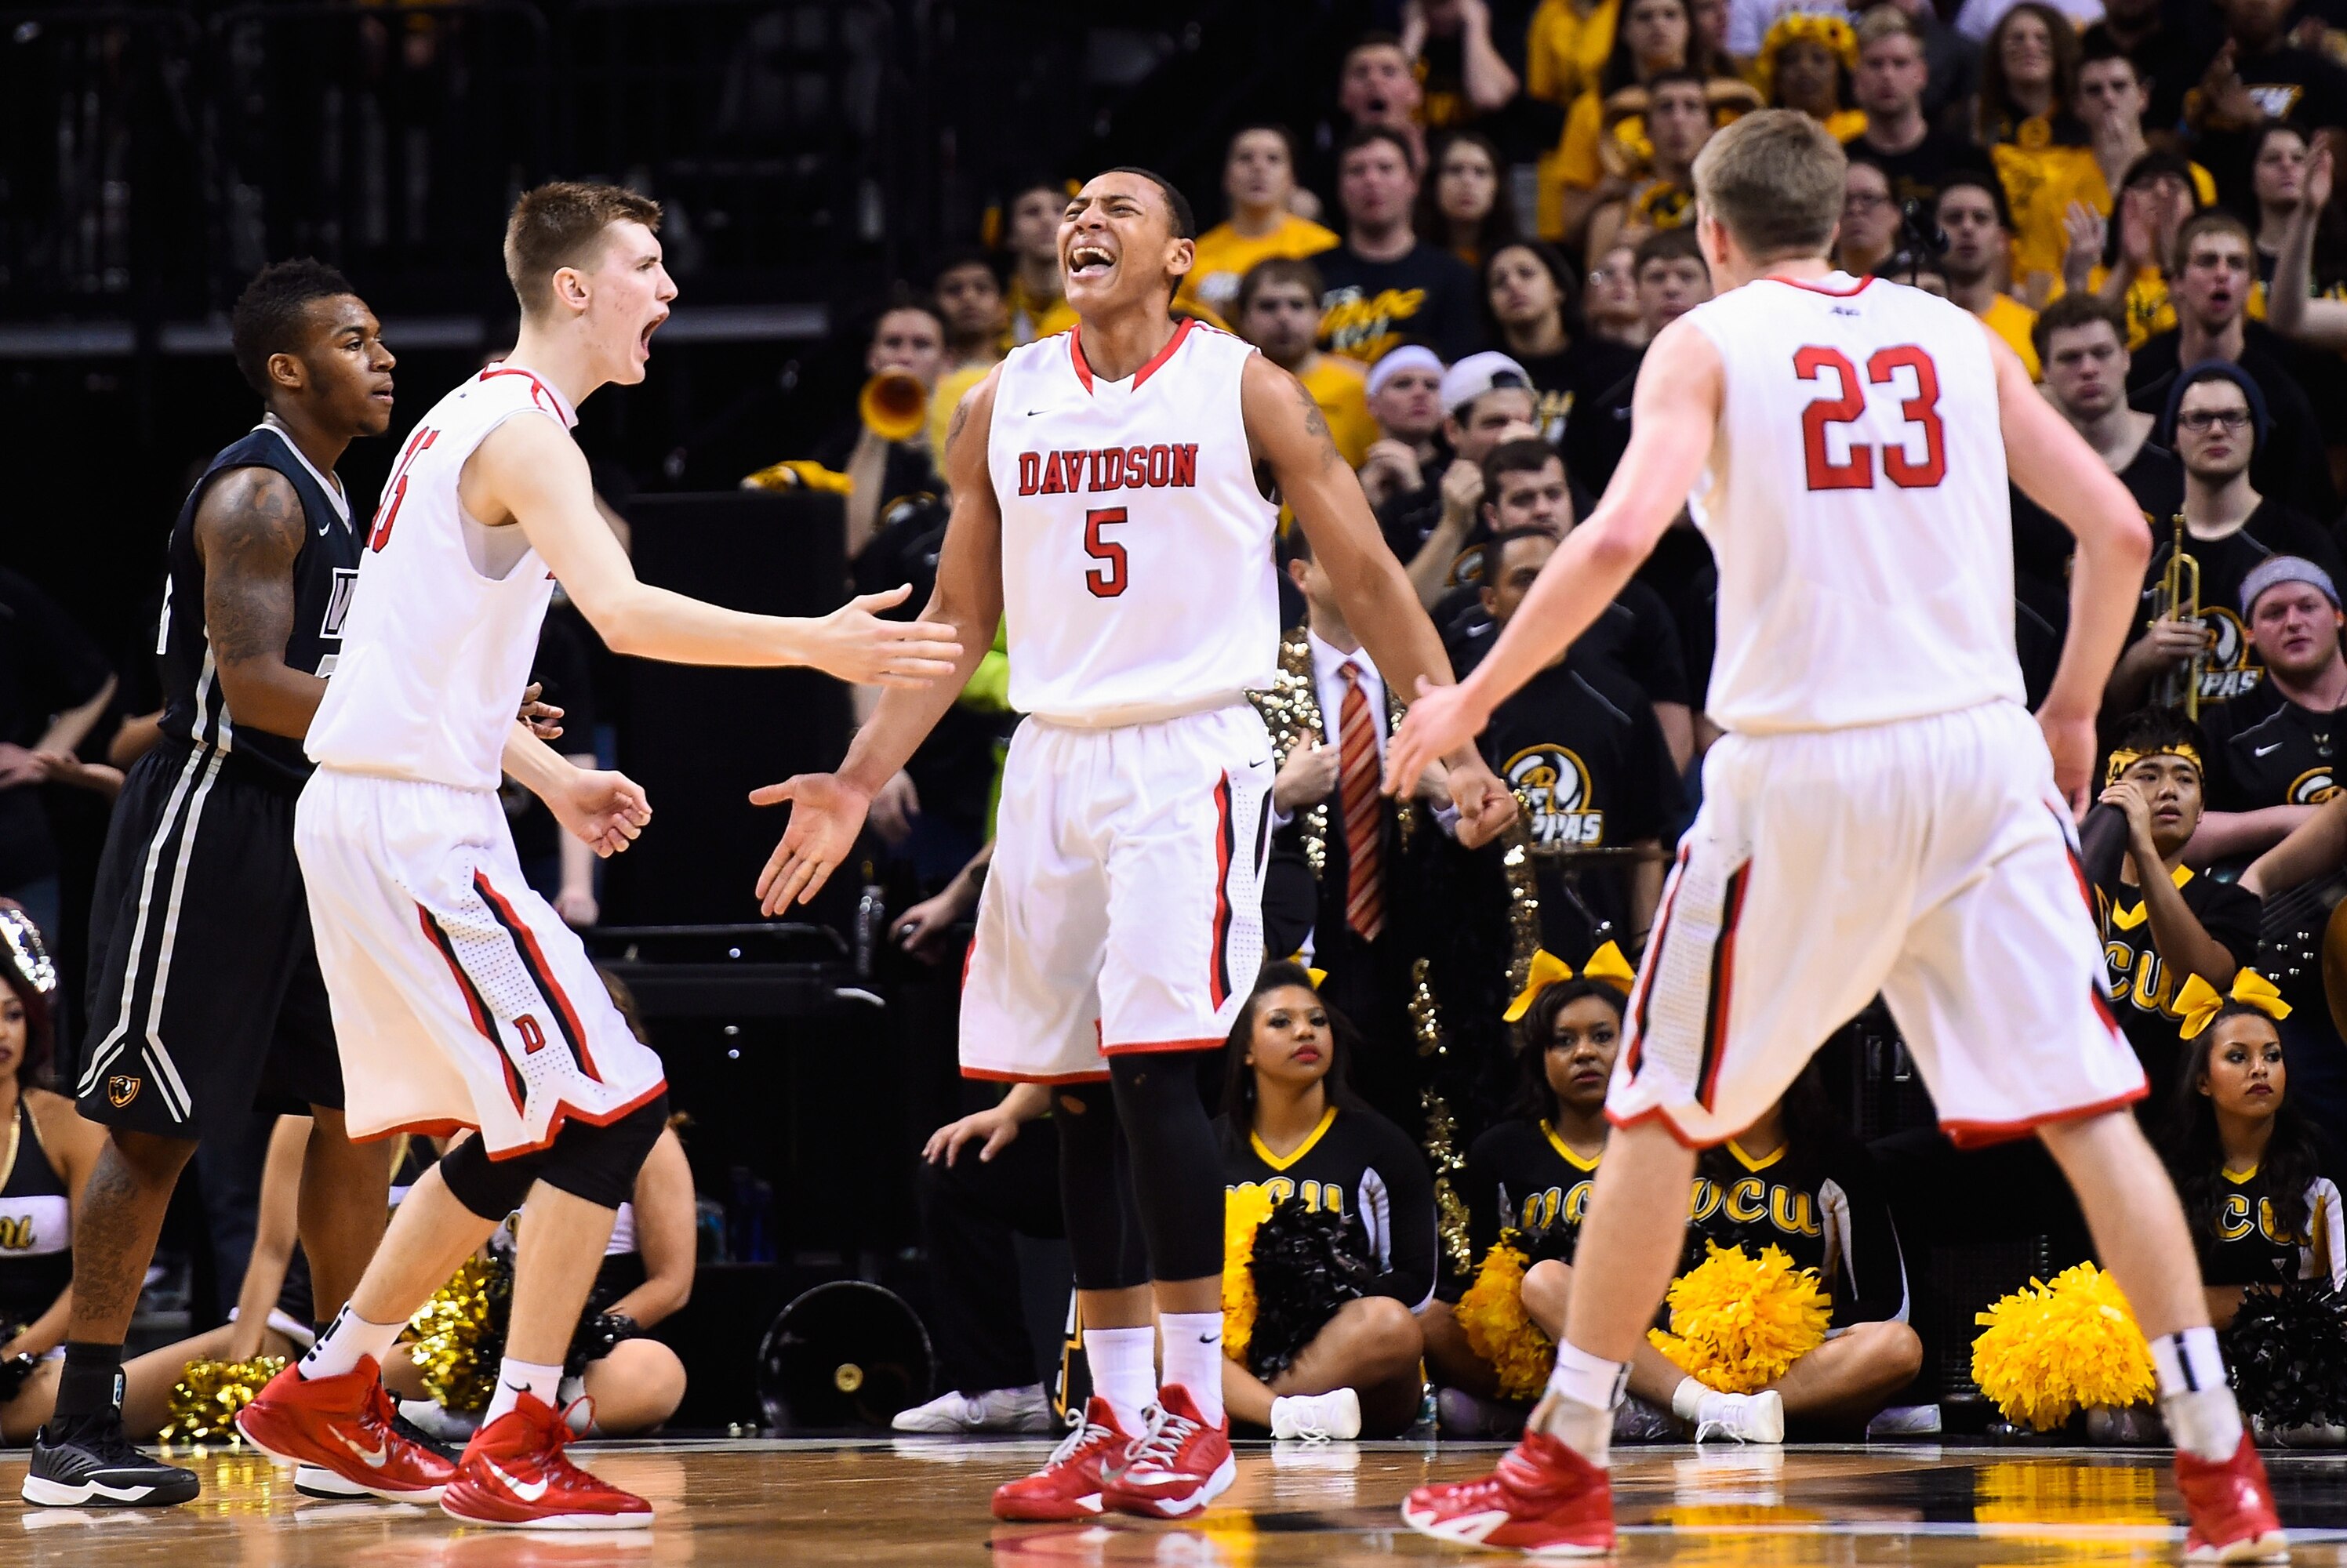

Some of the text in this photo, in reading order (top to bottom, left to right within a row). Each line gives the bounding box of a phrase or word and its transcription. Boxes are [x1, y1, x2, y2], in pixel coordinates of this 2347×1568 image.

[1793, 344, 1946, 490] 23
[1019, 443, 1199, 496] DAVIDSON
[1084, 506, 1128, 598] 5
[2105, 940, 2185, 1022] CU
[512, 1013, 547, 1056] D
[1690, 1177, 1822, 1238] VCU
[2210, 1193, 2310, 1247] CU
